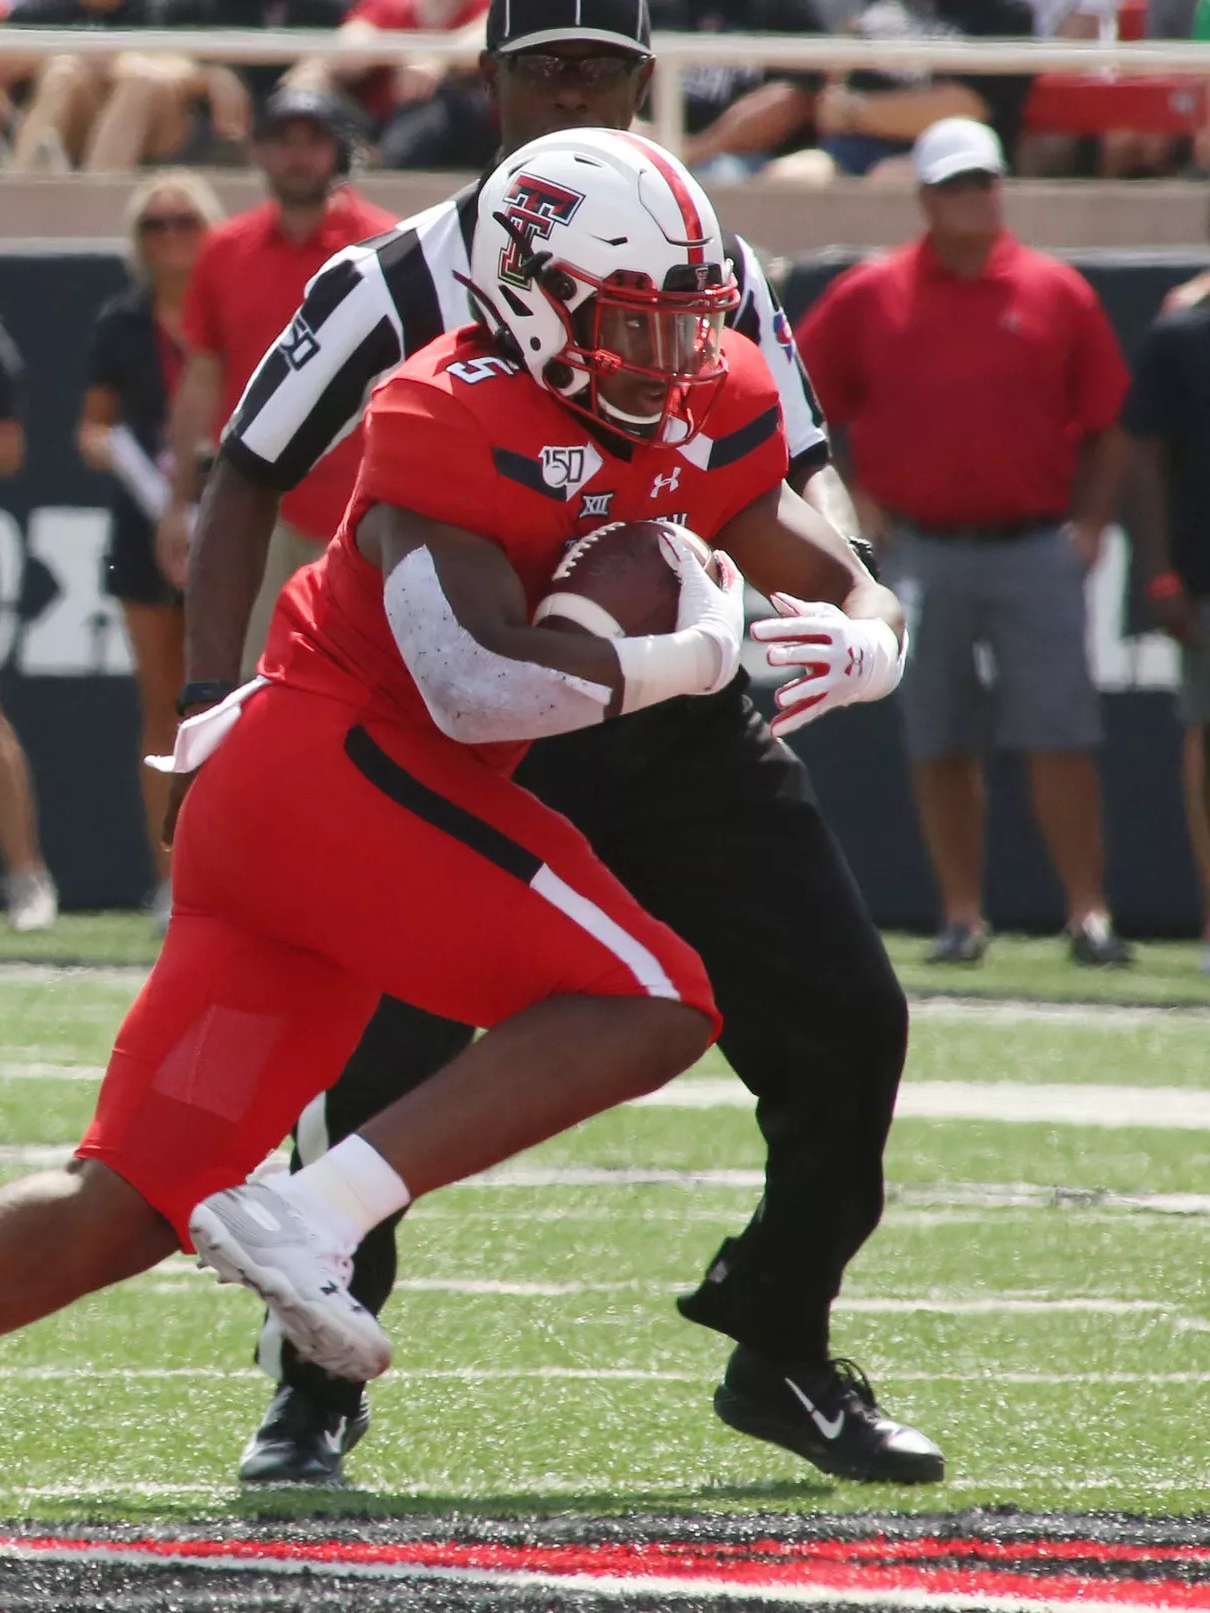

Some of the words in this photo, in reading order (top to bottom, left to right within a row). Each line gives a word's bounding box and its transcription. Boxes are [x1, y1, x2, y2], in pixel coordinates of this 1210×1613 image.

[446, 356, 514, 384] 5
[543, 448, 585, 485] 150
[579, 493, 614, 519] XII
